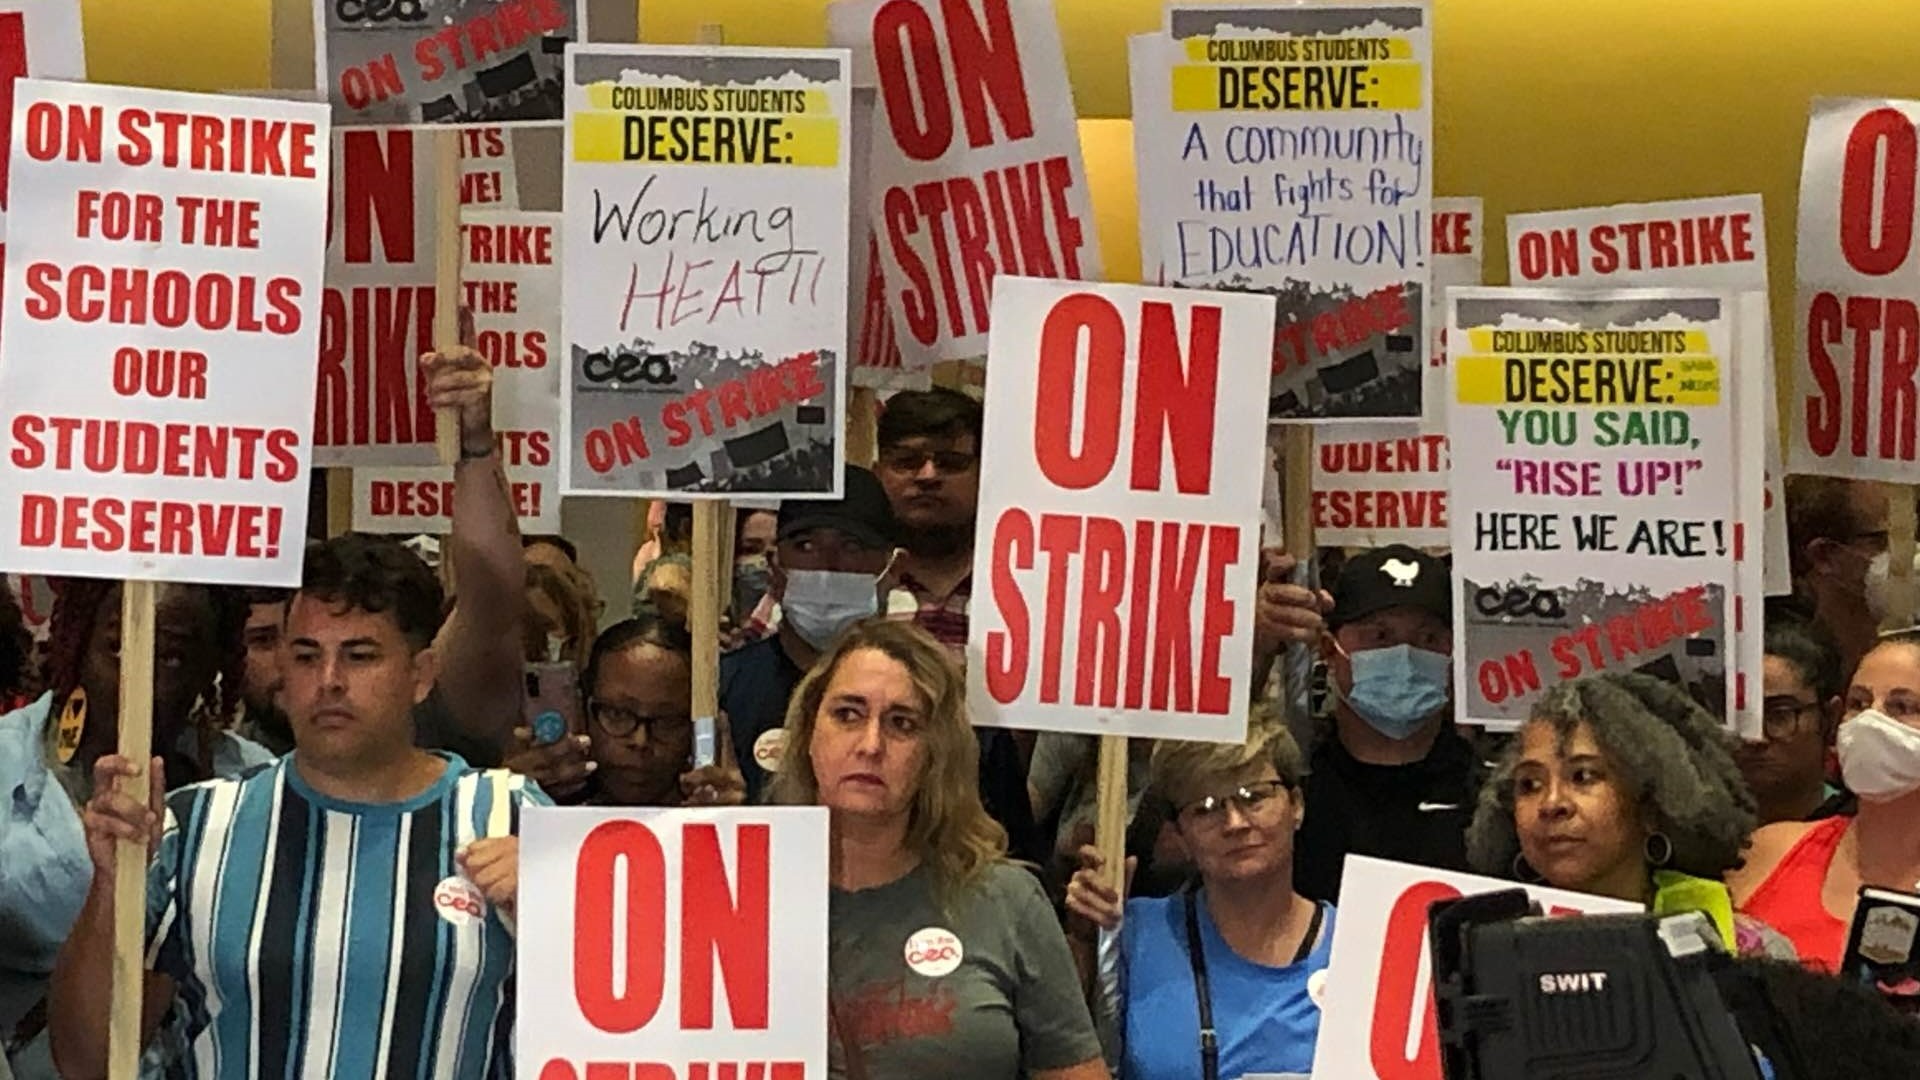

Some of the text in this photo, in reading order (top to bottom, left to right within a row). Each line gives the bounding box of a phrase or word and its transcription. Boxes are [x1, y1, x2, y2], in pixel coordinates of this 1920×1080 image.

[341, 0, 568, 111] ON STRIKE
[873, 0, 1035, 161] ON
[1207, 38, 1391, 62] COLUMBUS STUDENTS
[612, 86, 806, 114] COLUMBUS STUDENTS
[1218, 65, 1379, 110] DESERVE:
[25, 101, 317, 179] ON STRIKE
[623, 115, 793, 164] DESERVE:
[1182, 113, 1423, 196] A community
[76, 190, 260, 249] FOR THE
[326, 130, 415, 264] N
[1194, 175, 1252, 212] that
[1366, 168, 1417, 206] for
[461, 224, 552, 265] RIKE
[593, 174, 820, 275] Working
[884, 156, 1084, 347] STRIKE
[1177, 210, 1425, 278] EDUCATION!
[1518, 228, 1580, 281] ON
[1590, 213, 1755, 274] STRIKE
[24, 262, 303, 336] SCHOOLS
[113, 347, 208, 400] OUR
[313, 286, 437, 446] RIKE
[583, 353, 677, 384] cea
[1493, 330, 1687, 354] COLUMBUS STUDENTS
[585, 416, 650, 474] ON
[661, 350, 825, 447] STRIKE
[1034, 293, 1222, 495] ON
[1505, 359, 1675, 404] DESERVE:
[10, 414, 300, 483] STUDENTS
[1497, 410, 1700, 450] YOU SAID,
[20, 494, 283, 559] DESERVE!
[1475, 512, 1727, 557] HERE WE ARE!
[985, 507, 1240, 715] STRIKE
[1475, 588, 1566, 618] cea
[1478, 584, 1714, 703] ON STRIKE
[574, 819, 770, 1034] ON
[1540, 971, 1607, 993] SWIT
